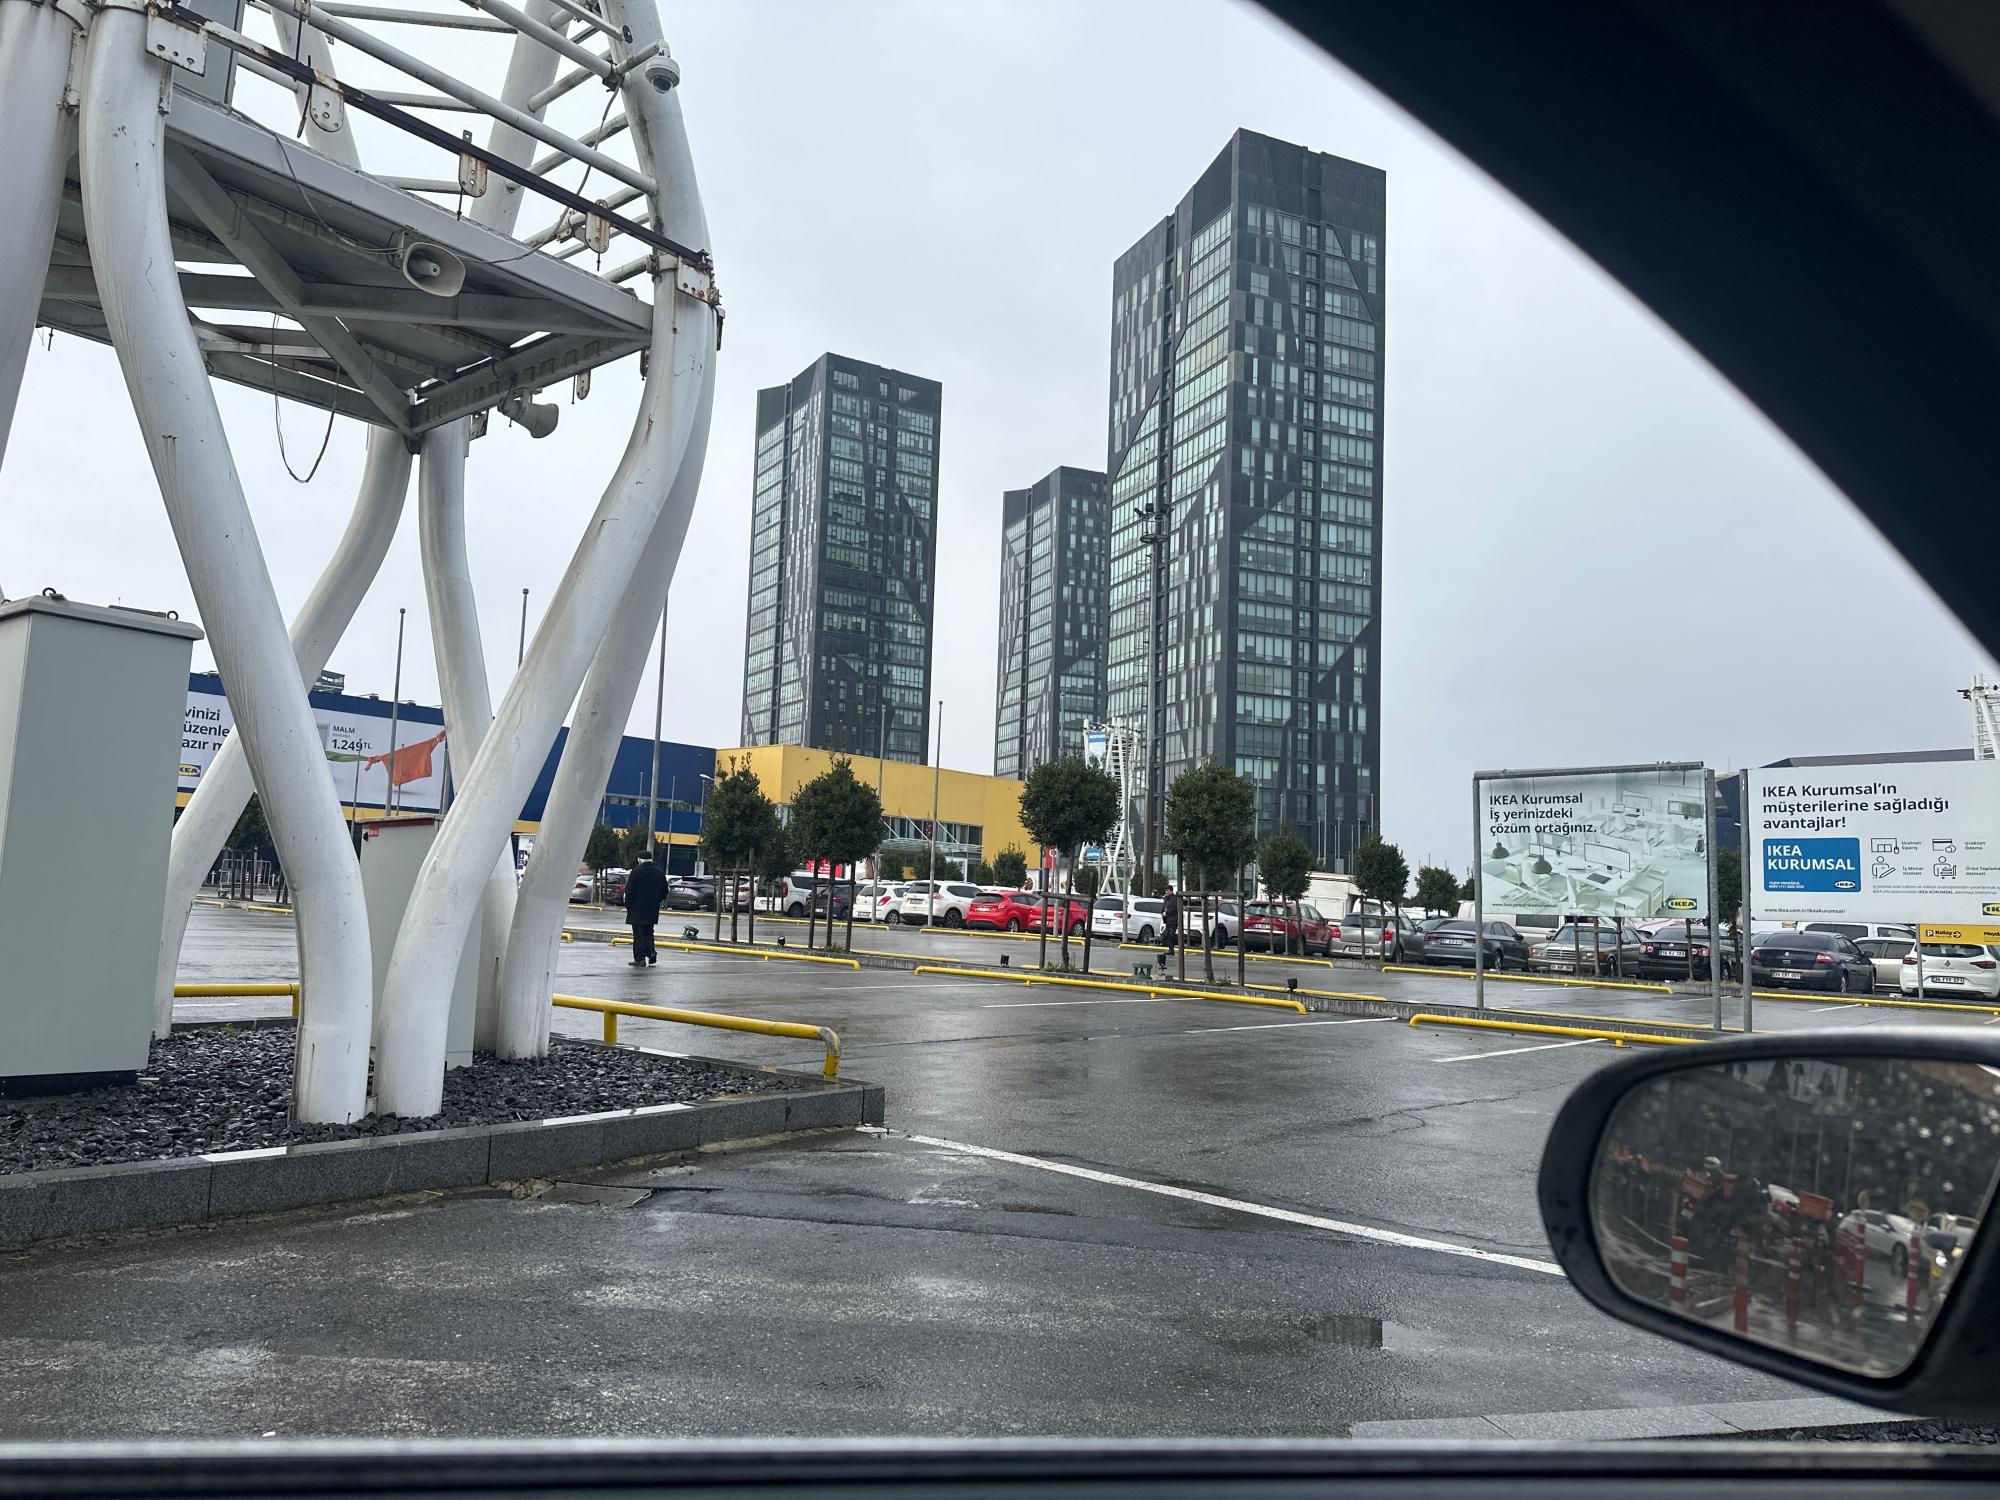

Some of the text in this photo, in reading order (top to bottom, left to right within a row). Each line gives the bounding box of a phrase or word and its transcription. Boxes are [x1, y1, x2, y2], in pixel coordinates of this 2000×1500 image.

[186, 706, 220, 720] vinizi
[184, 720, 230, 737] üzenle
[332, 726, 355, 734] MALM
[182, 738, 208, 750] azır
[1763, 786, 1798, 798] IKEA
[1490, 793, 1583, 806] IKEA Kurumsal
[1764, 797, 1950, 815] müşterilerine sağladığı
[1490, 807, 1574, 823] İş yerinizdeki
[1490, 821, 1598, 836] çözüm ortağınız.
[1764, 816, 1846, 832] avantajlar!
[1768, 845, 1802, 856] IKEA
[1768, 858, 1856, 870] KURUMSAL
[1670, 900, 1696, 908] IKEA
